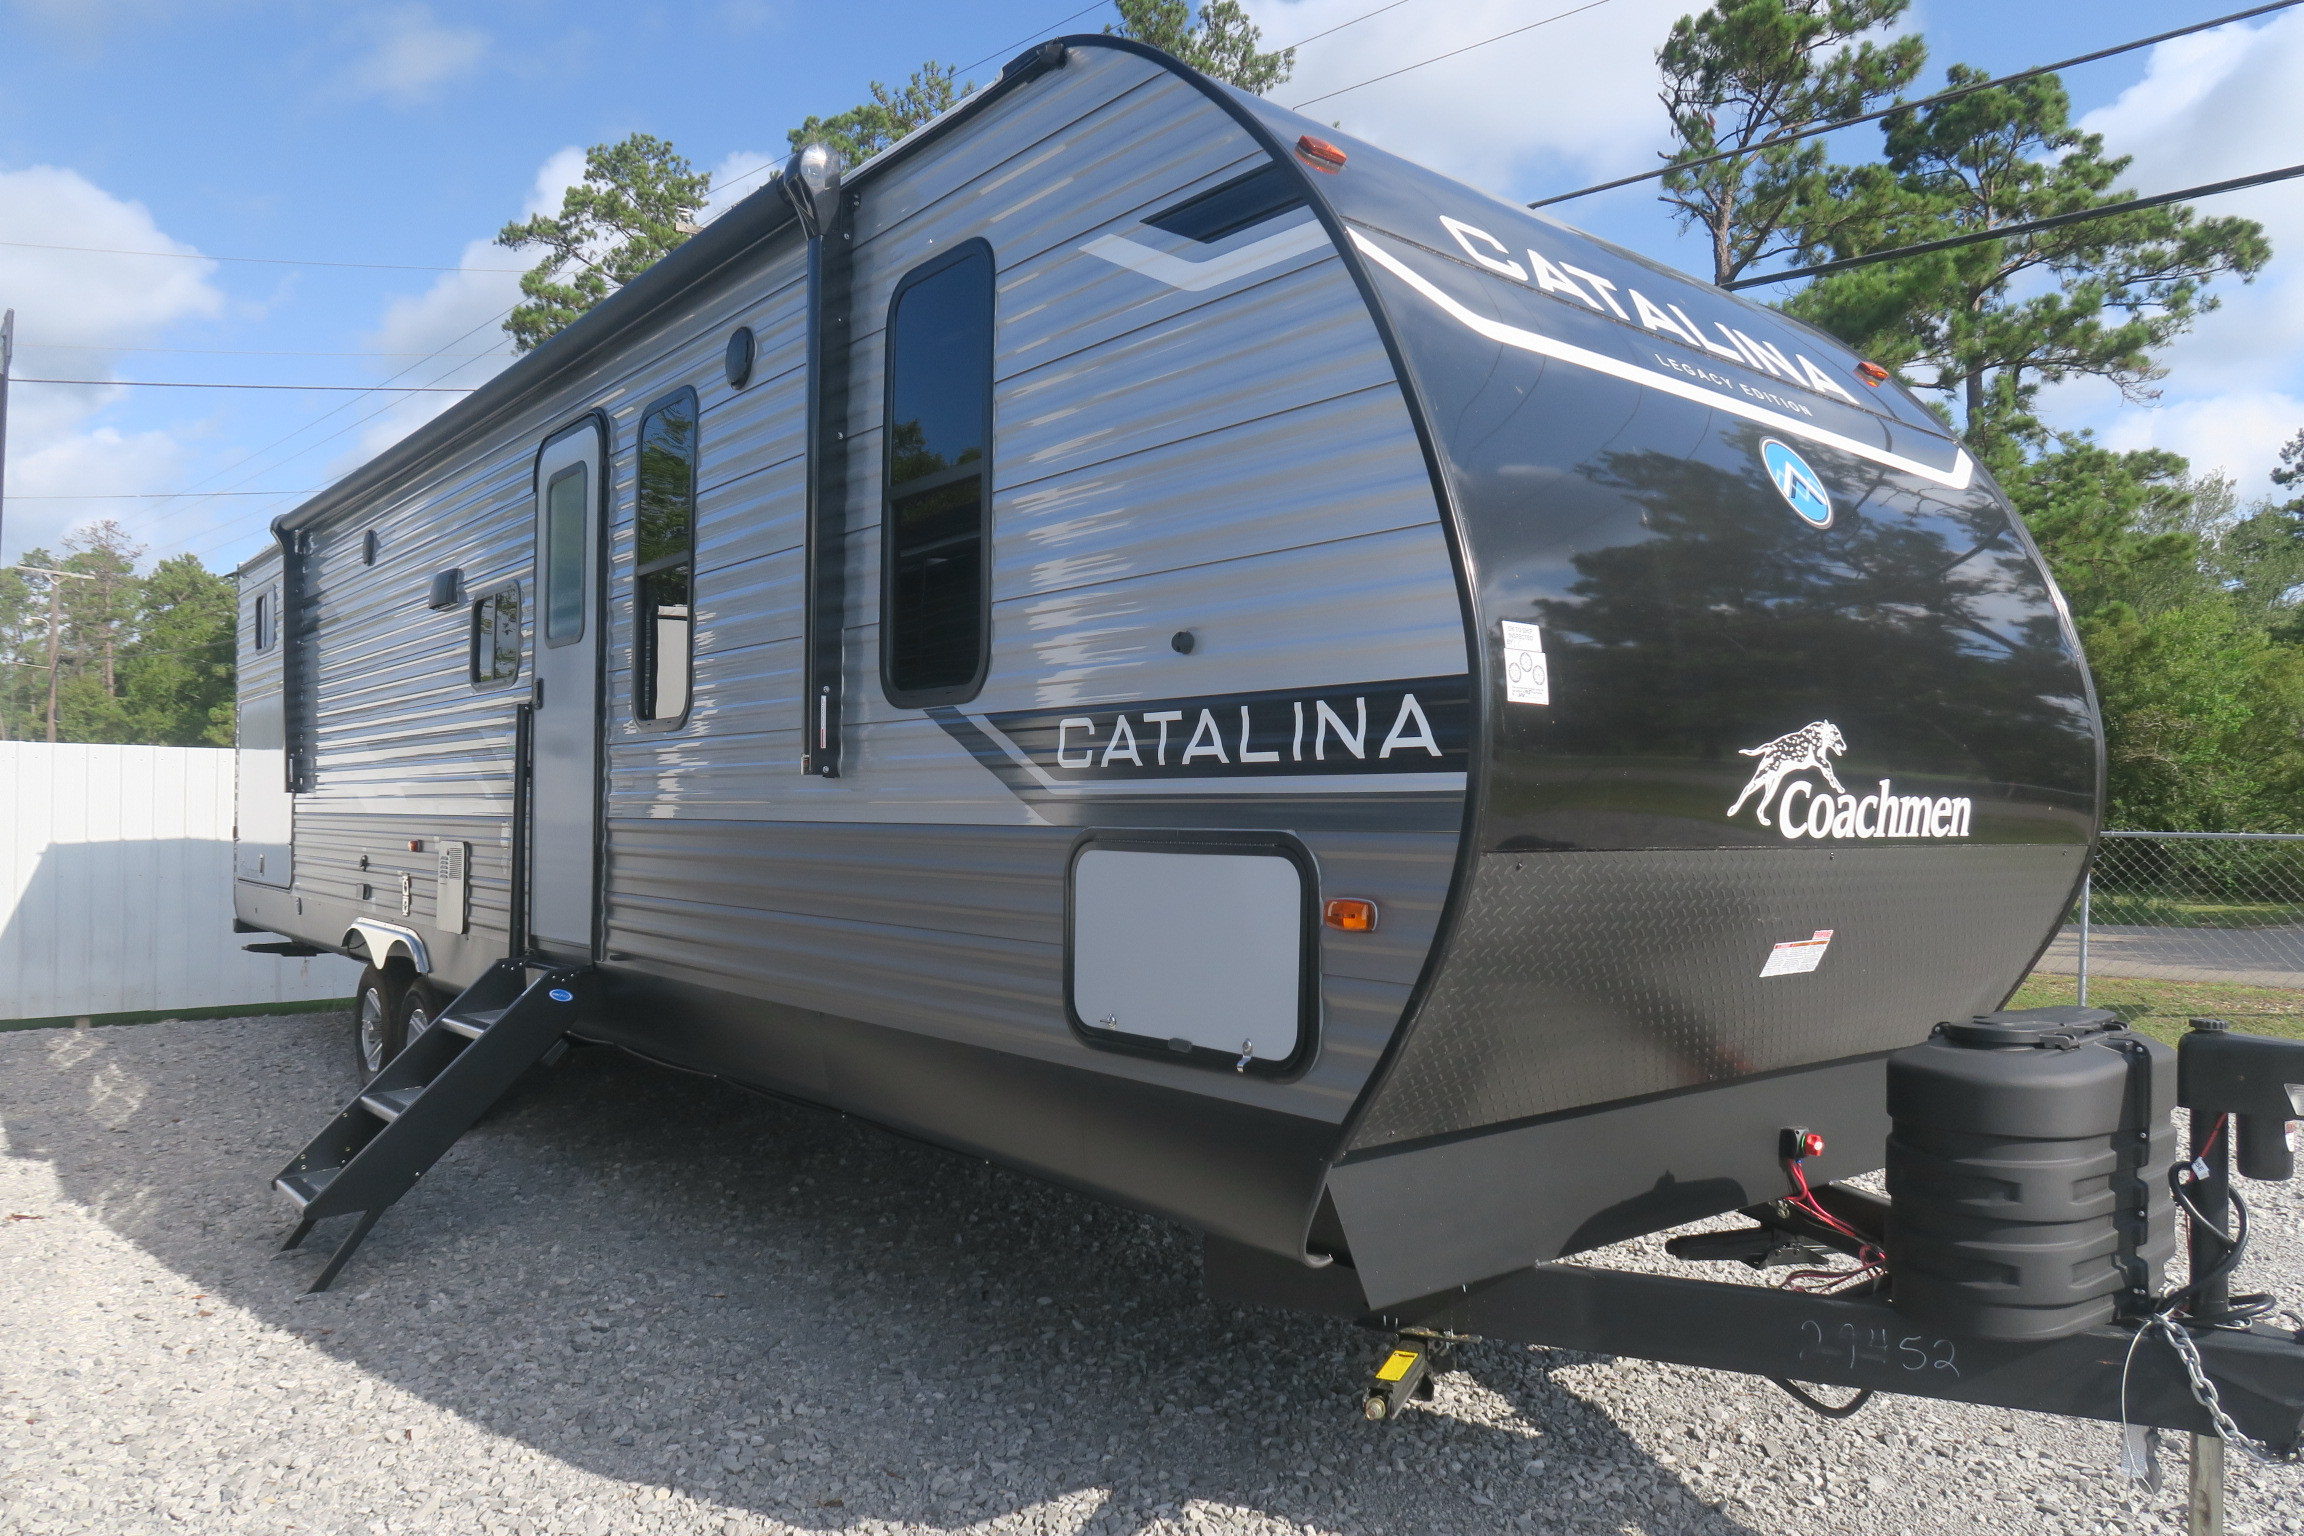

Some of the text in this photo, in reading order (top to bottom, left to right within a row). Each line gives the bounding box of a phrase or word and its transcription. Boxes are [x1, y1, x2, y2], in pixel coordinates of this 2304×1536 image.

[1439, 215, 1860, 405] CATALINA
[1655, 353, 1813, 417] LEGACY EDITION
[1057, 693, 1443, 769] CATALINA
[1778, 778, 1972, 839] Coachmen
